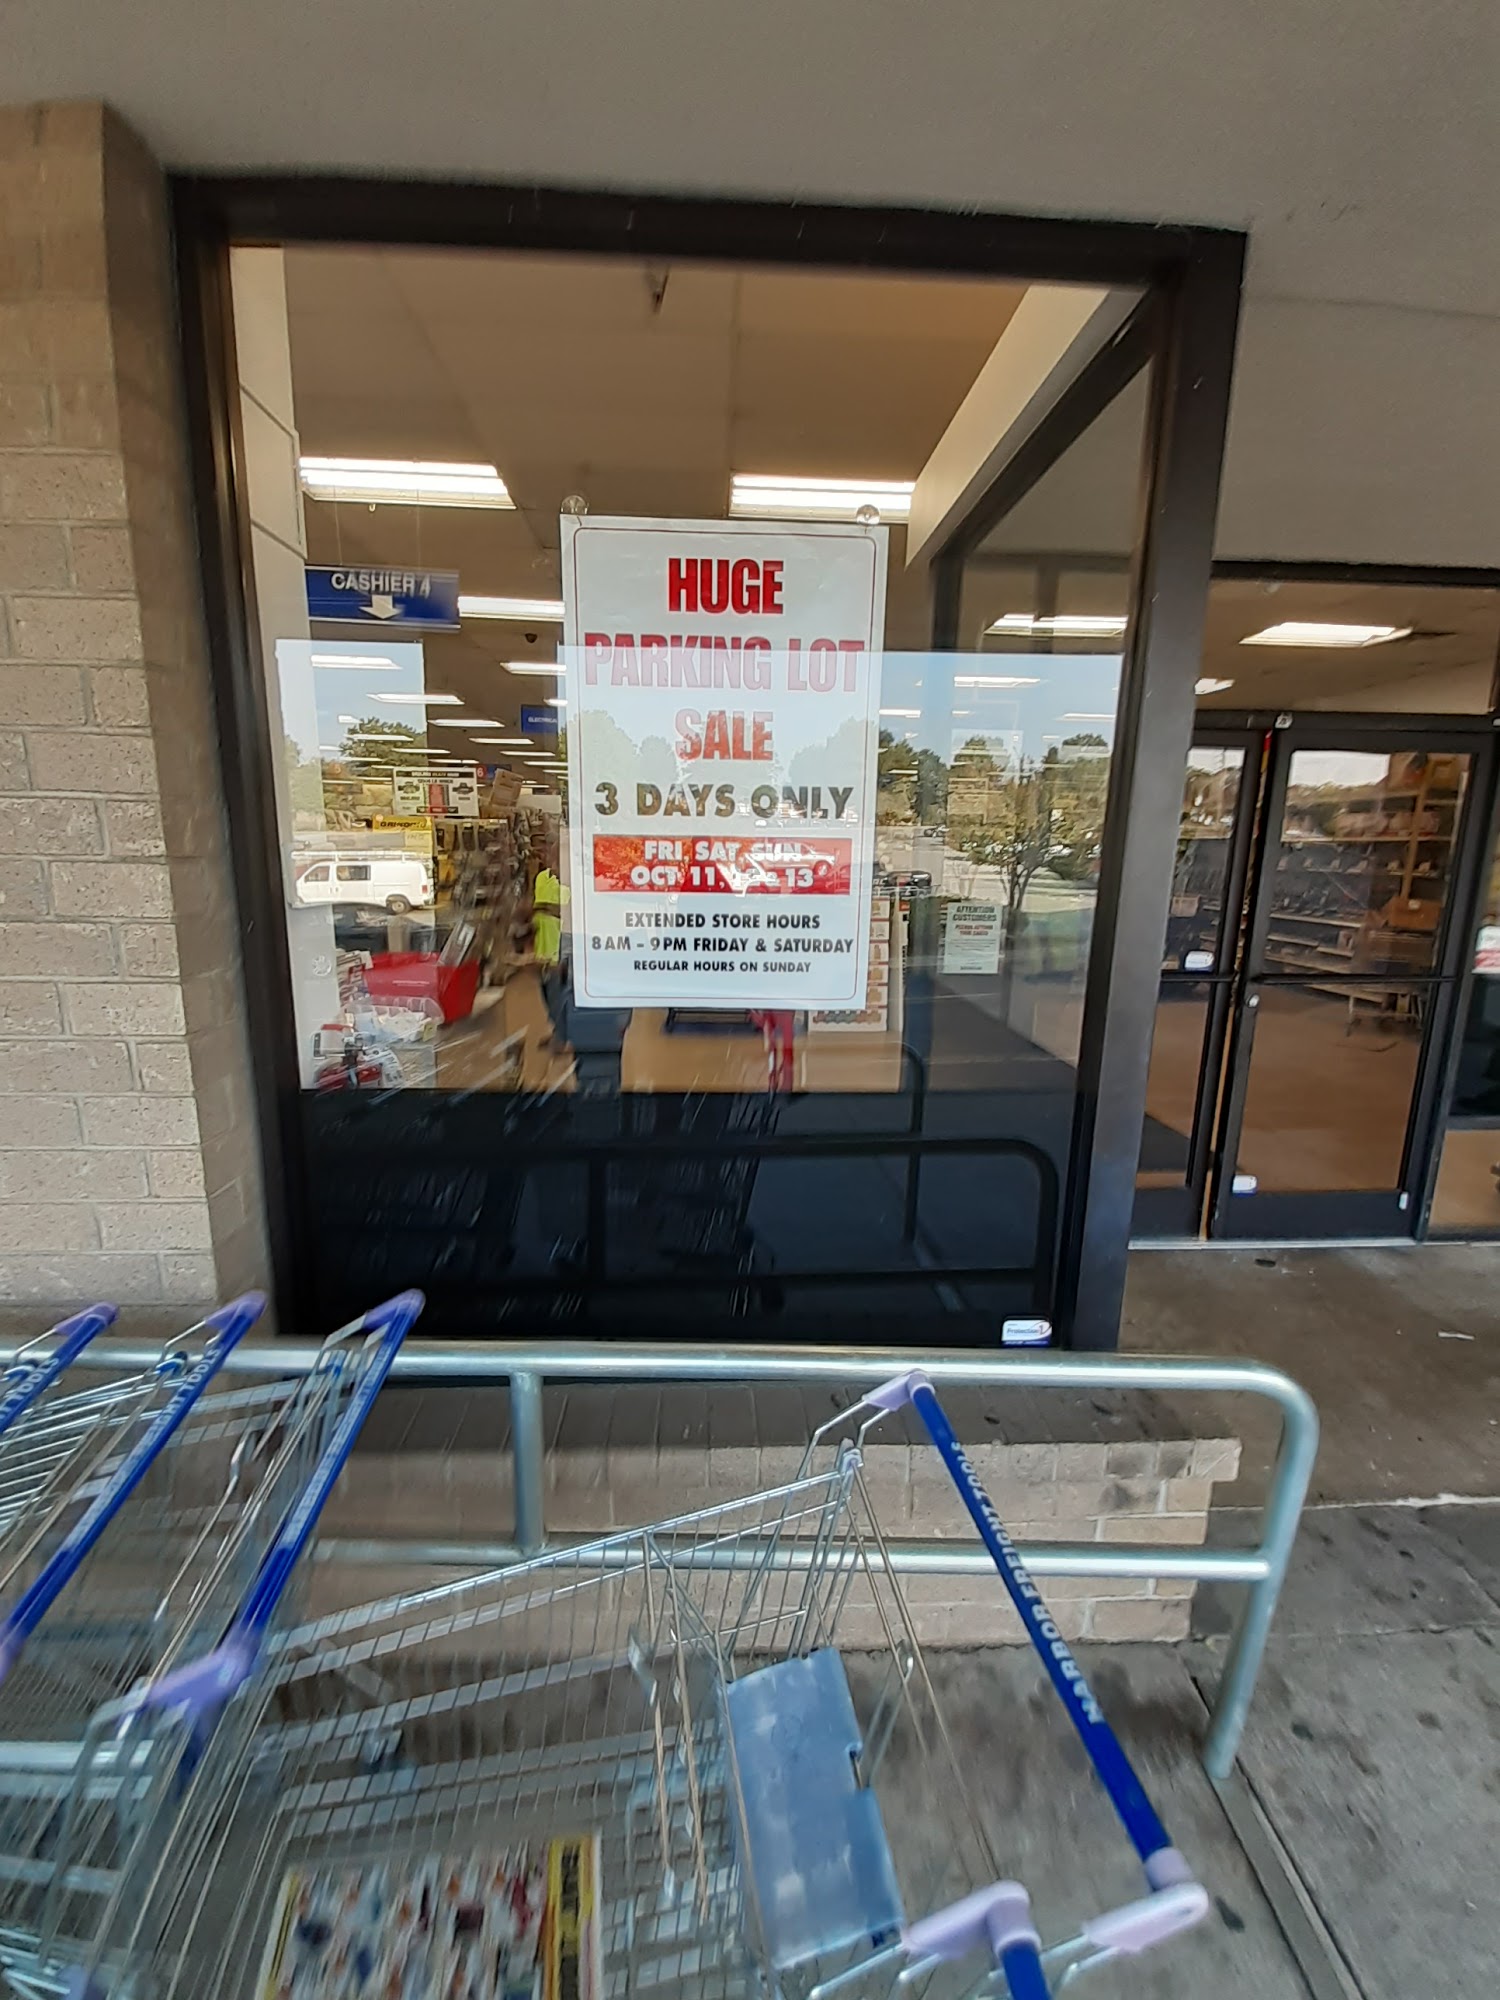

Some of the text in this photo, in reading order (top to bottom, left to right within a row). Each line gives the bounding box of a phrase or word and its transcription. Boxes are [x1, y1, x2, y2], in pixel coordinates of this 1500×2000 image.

[331, 571, 415, 595] CASHIER
[668, 557, 784, 614] HUGE
[584, 632, 865, 692] PARKING LOT
[675, 708, 774, 761] SALE
[477, 767, 484, 777] 6
[595, 782, 854, 819] 3 DAYS ONLY
[751, 843, 802, 862] SUN
[690, 866, 725, 889] 11,
[785, 868, 813, 887] 13
[625, 913, 820, 929] EXTENDED STORE HOURS
[694, 938, 748, 951] FRIDAY
[755, 938, 767, 951] &
[774, 939, 853, 953] SATURDAY
[634, 960, 811, 972] REGULAR HOURS ON SUNDAY
[4, 1358, 60, 1405] TOOLS
[180, 1349, 221, 1391] TOOLS
[951, 1441, 991, 1500] TOOLS
[981, 1503, 1041, 1599] FREIGHT
